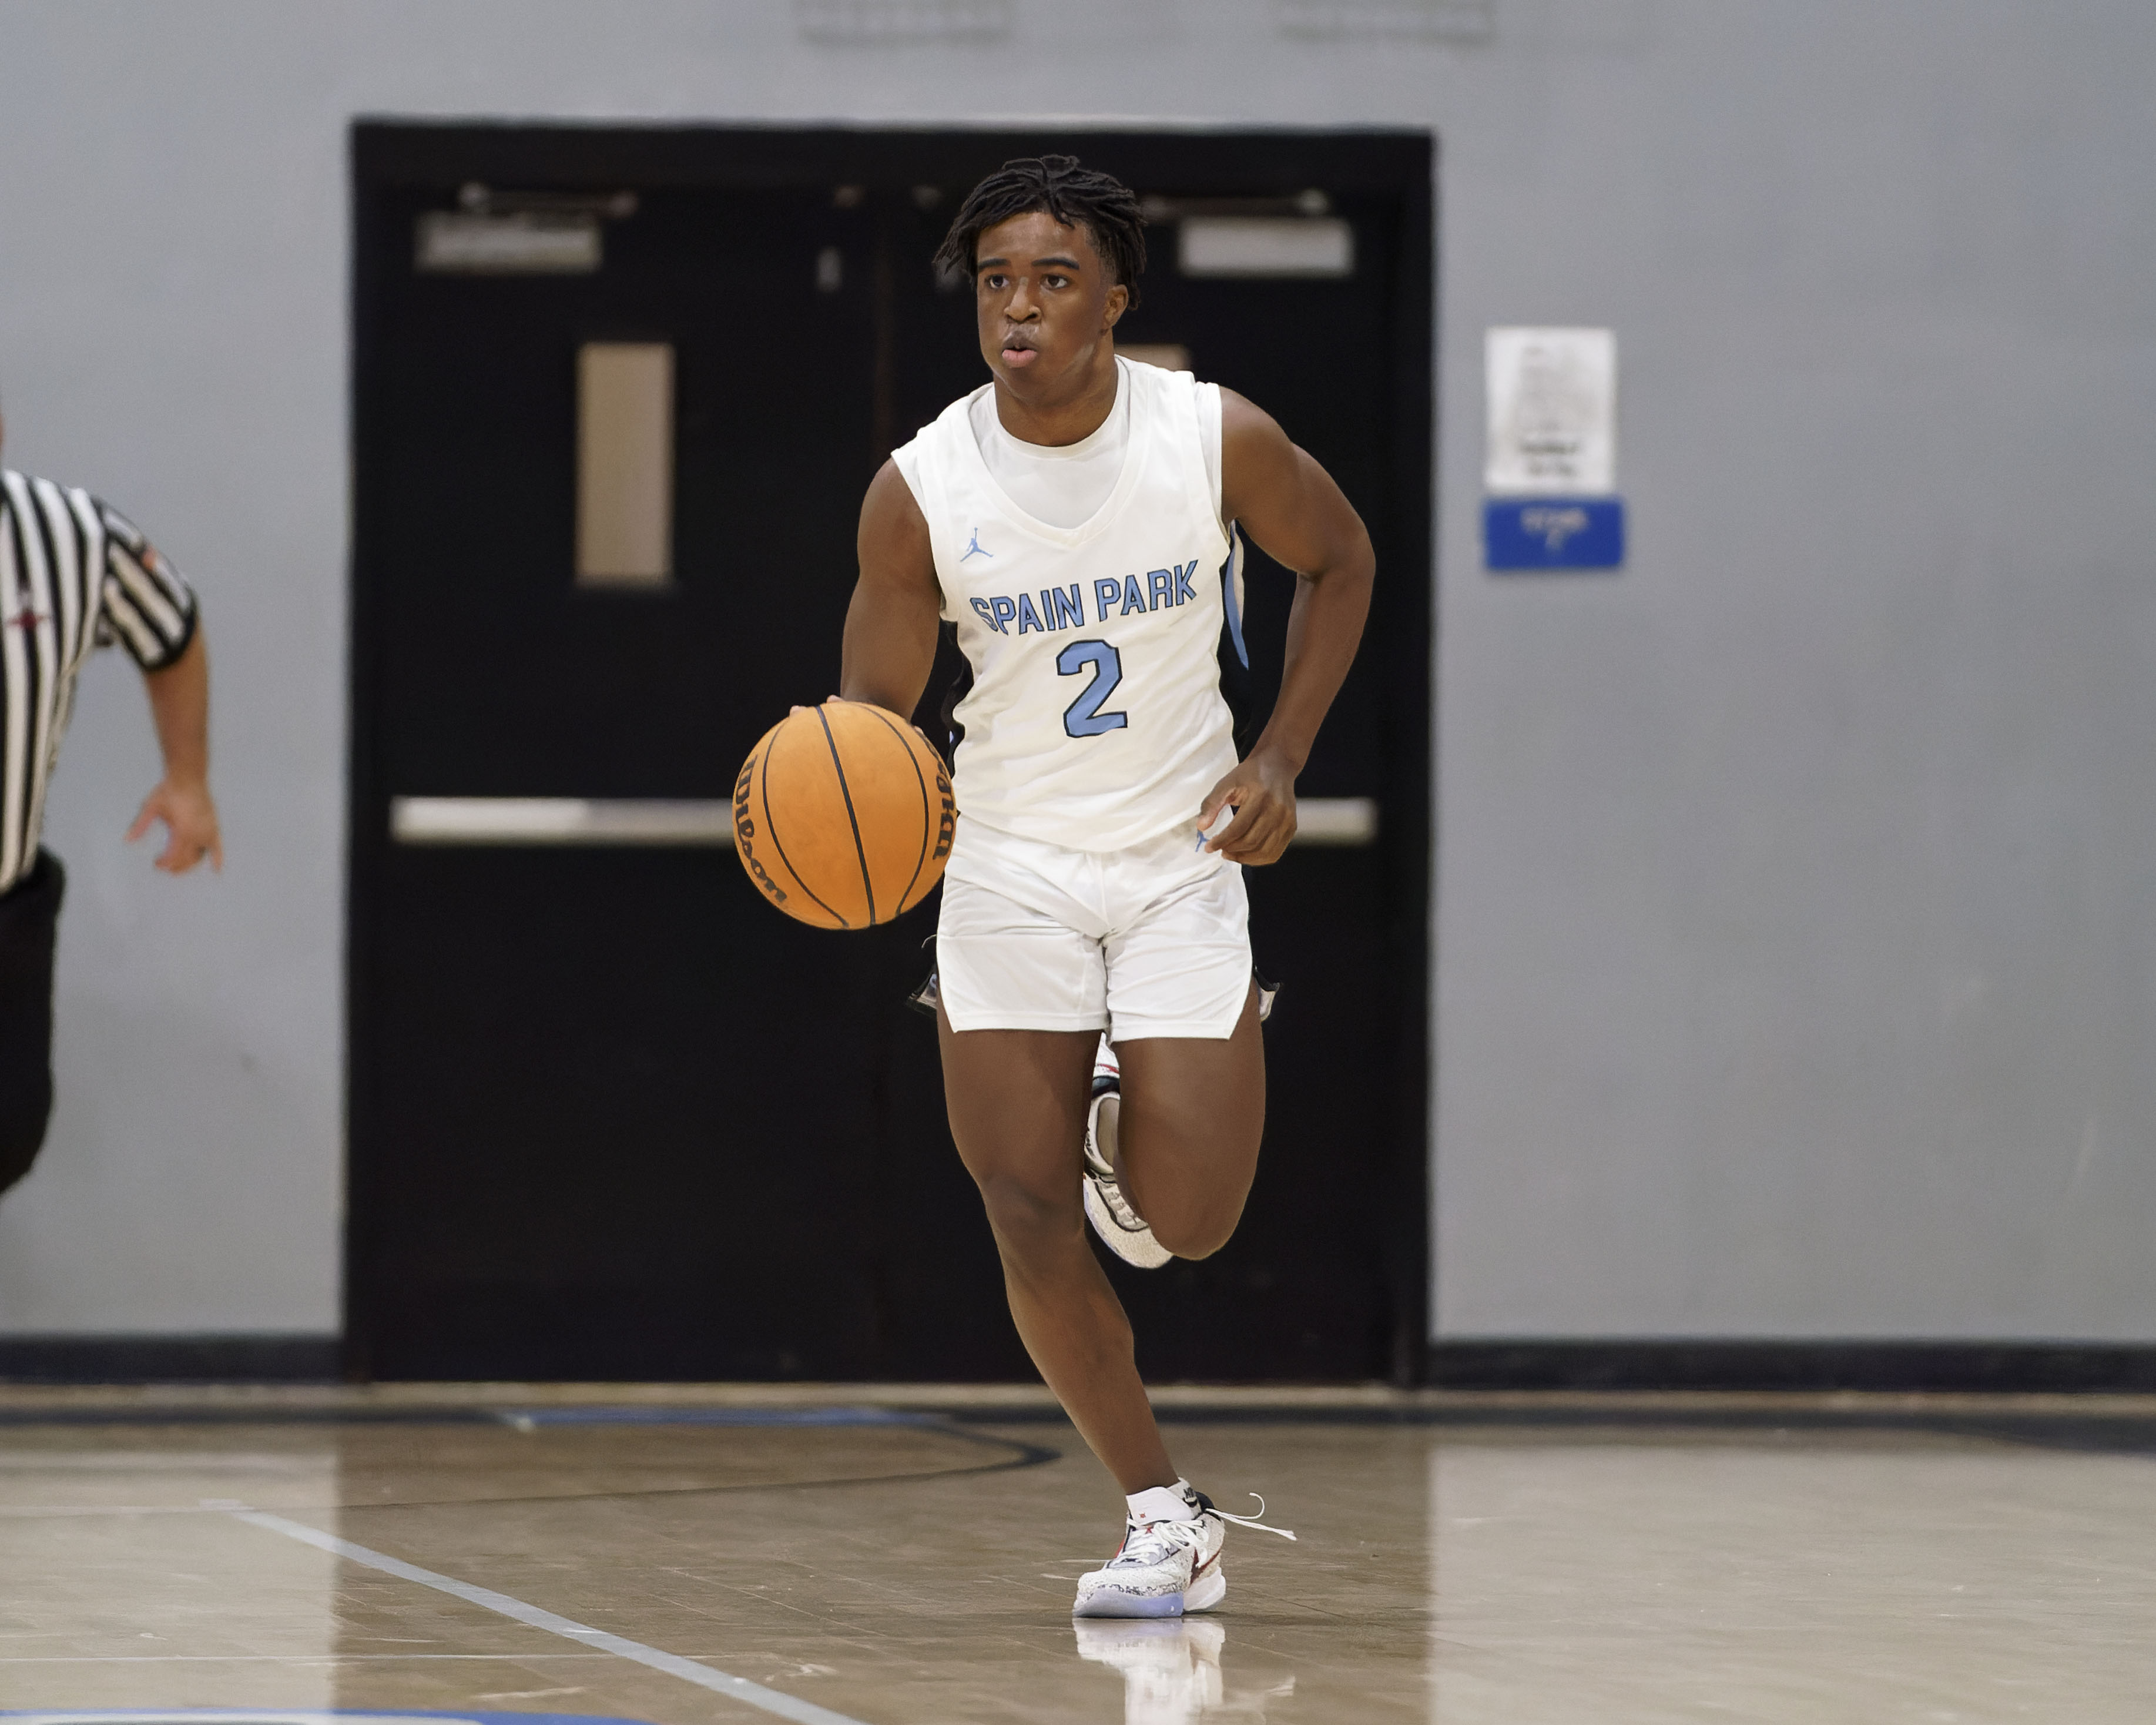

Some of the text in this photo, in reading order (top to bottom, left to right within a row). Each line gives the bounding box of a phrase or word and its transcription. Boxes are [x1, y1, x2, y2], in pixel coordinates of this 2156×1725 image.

[970, 560, 1199, 635] SPAIN PARK
[1056, 639, 1128, 738] 2
[736, 754, 787, 903] Wilson
